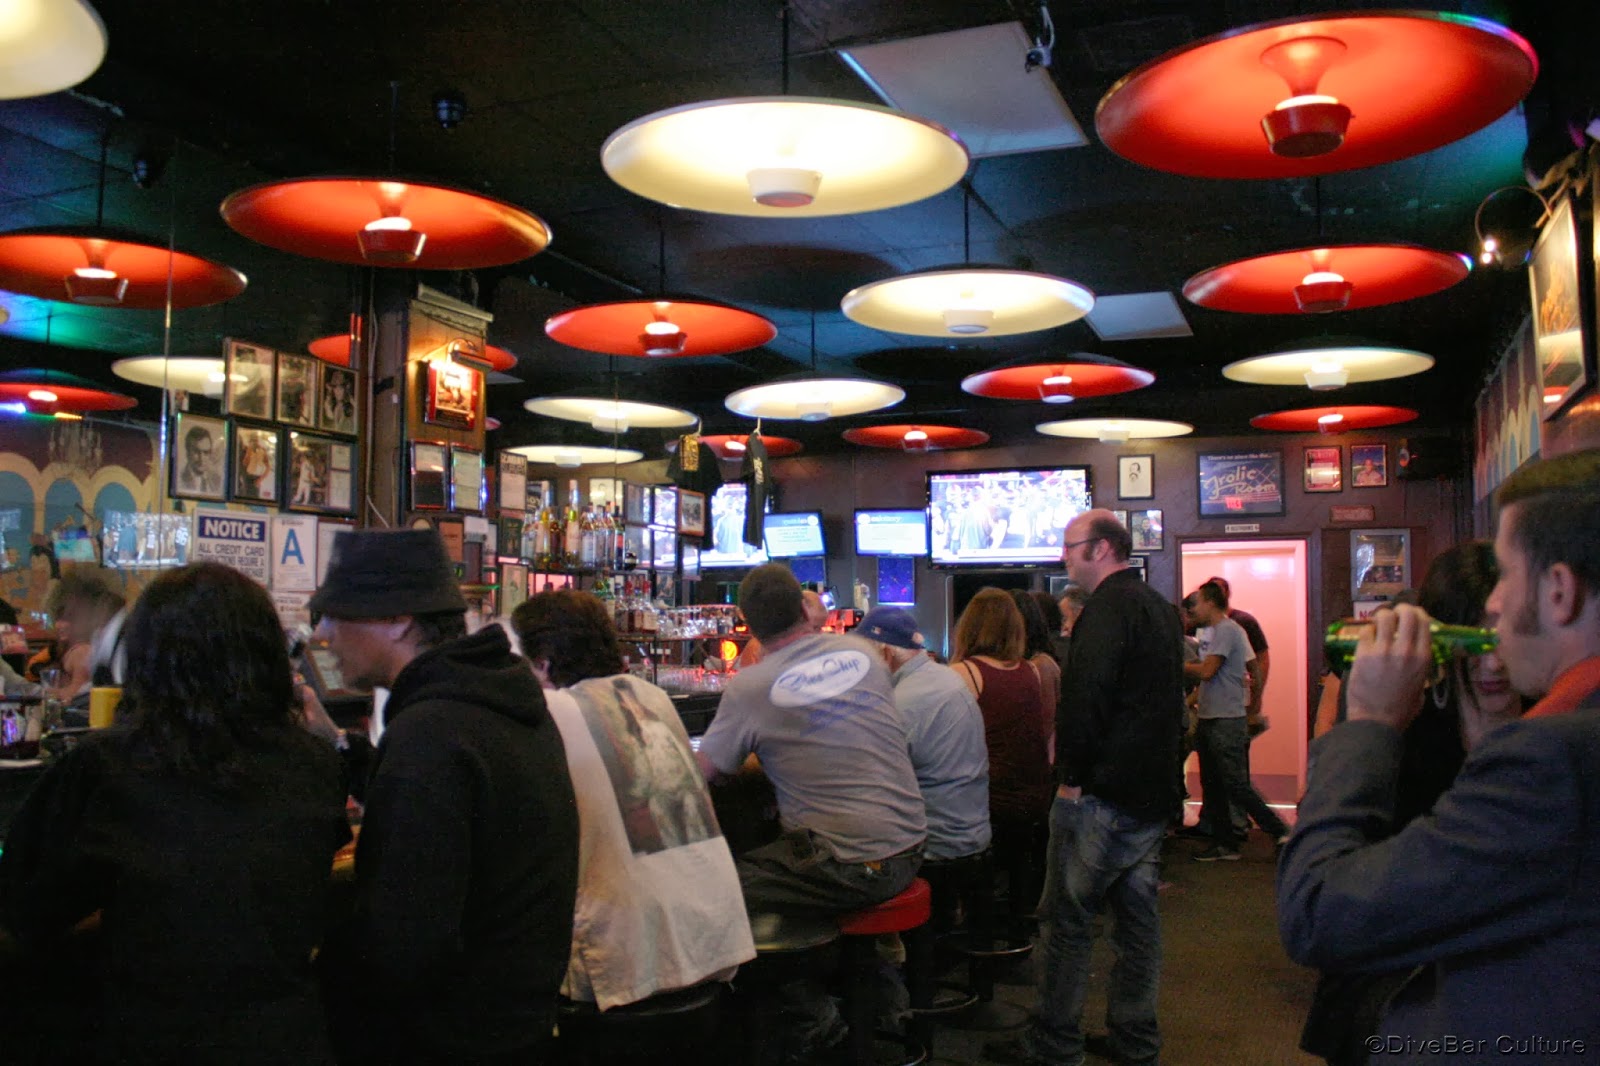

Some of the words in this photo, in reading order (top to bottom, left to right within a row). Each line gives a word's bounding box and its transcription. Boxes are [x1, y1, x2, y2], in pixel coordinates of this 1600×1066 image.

[1203, 465, 1257, 500] Frolic
[1234, 482, 1276, 495] Room
[204, 518, 261, 540] NOTICE
[198, 543, 212, 554] ALL
[215, 544, 242, 555] CREDIT
[245, 546, 265, 557] CARD
[281, 528, 305, 565] A
